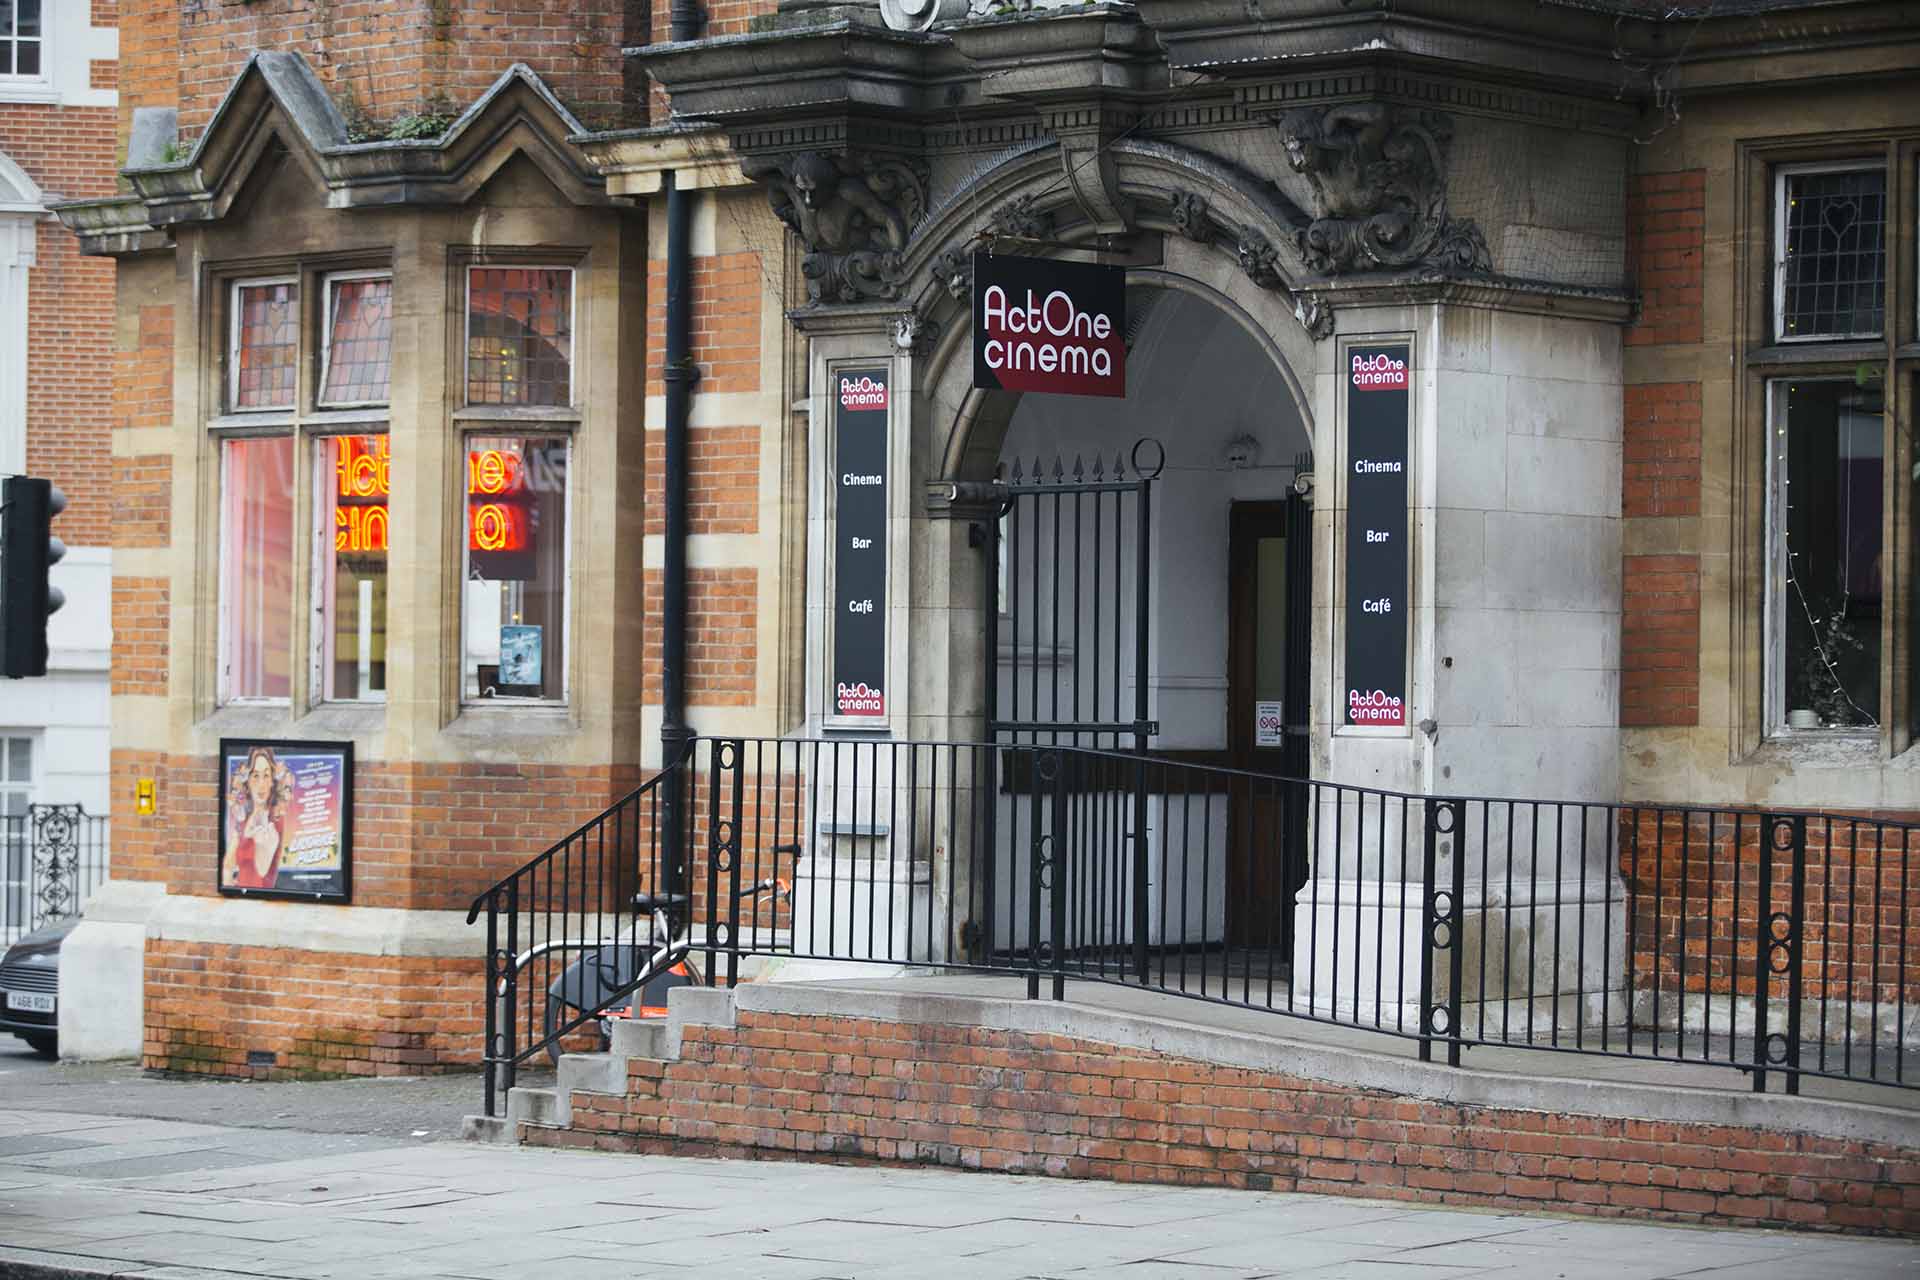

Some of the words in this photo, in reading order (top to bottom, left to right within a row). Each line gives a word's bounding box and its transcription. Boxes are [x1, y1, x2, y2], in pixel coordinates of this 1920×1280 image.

[984, 285, 1111, 339] ActOne
[984, 340, 1111, 376] cinema
[1352, 354, 1404, 371] ActOne
[840, 377, 885, 393] ActOne
[1352, 372, 1404, 385] cinema
[840, 393, 884, 405] cinema
[1355, 460, 1402, 473] Cinema
[842, 473, 882, 486] Cinema
[852, 536, 873, 549] Bar
[1366, 529, 1390, 543] Bar
[848, 600, 873, 615] Café
[1362, 598, 1391, 615] Café
[837, 682, 880, 698] ActOne
[837, 699, 880, 710] cinema
[1349, 689, 1400, 706] ActOne
[1349, 707, 1400, 719] cinema
